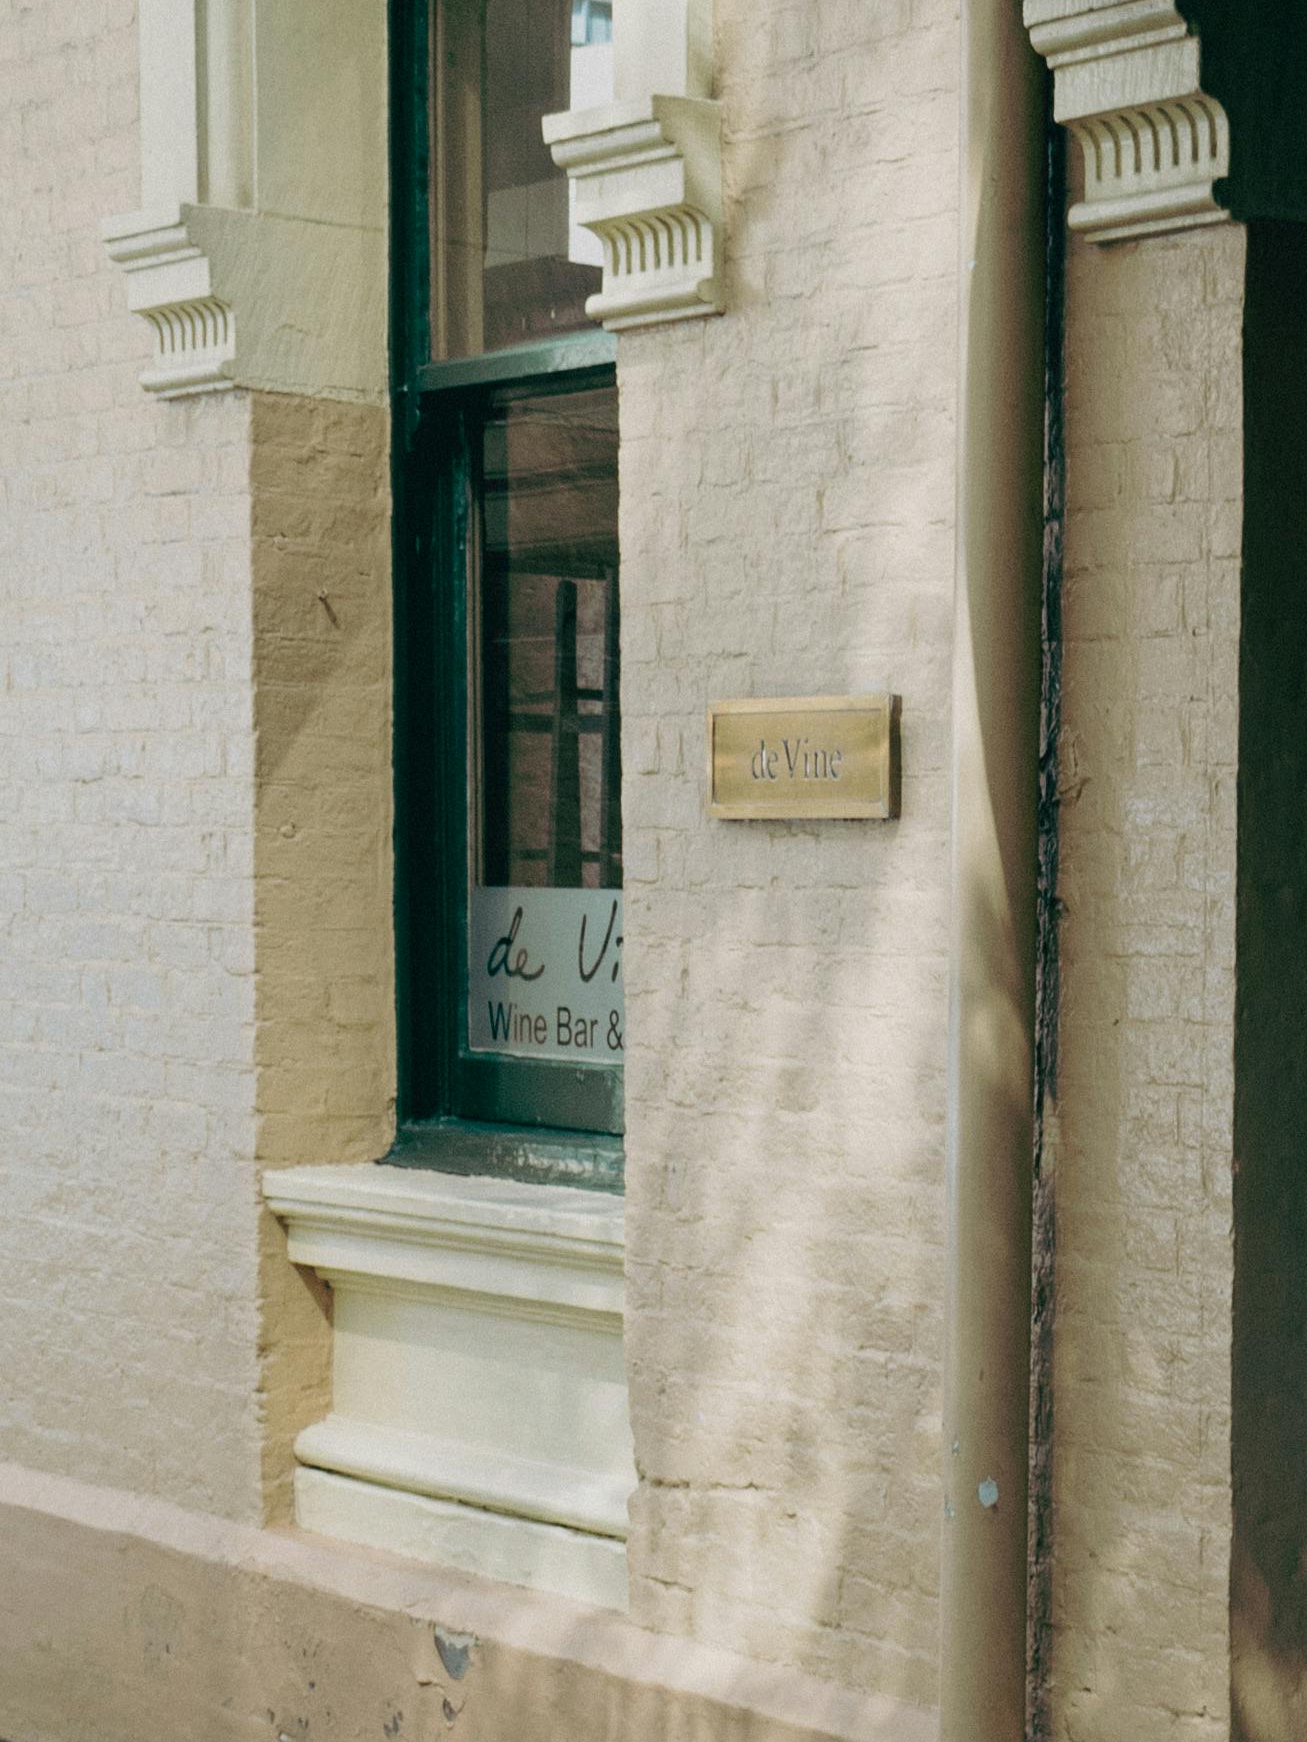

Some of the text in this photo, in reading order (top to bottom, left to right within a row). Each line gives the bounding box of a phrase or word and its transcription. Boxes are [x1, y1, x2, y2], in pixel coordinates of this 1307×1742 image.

[487, 899, 623, 983] de Vi
[488, 1000, 623, 1051] Wine Bar &
